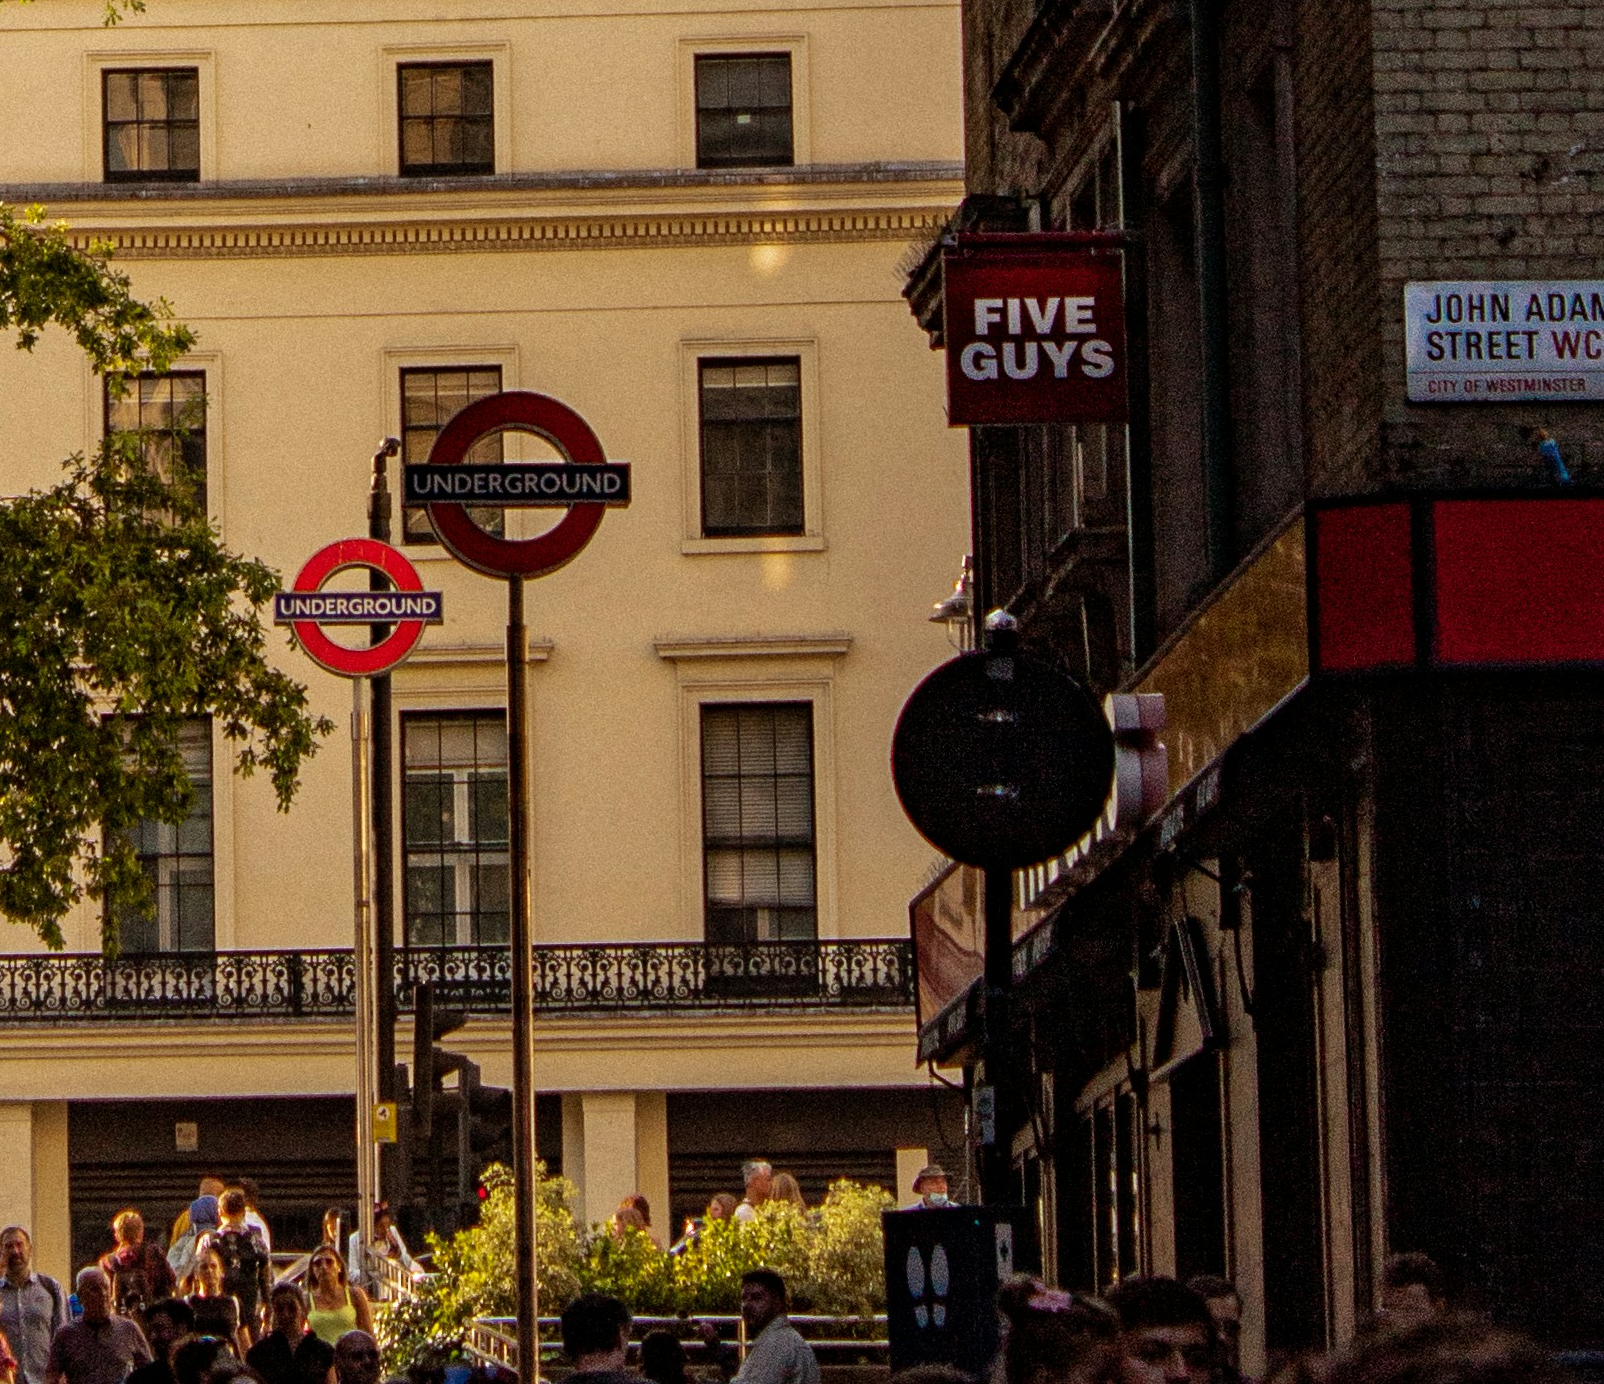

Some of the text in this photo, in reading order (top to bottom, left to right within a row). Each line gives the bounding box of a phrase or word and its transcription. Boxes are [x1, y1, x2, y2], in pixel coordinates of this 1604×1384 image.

[974, 297, 1096, 335] FIVE
[1426, 293, 1510, 324] JOHN
[960, 339, 1115, 380] GUYS
[1427, 330, 1539, 361] STREET
[1427, 377, 1586, 394] CITY OF WESTMINSTER
[413, 472, 621, 494] UNDERGROUND
[280, 597, 437, 616] UNDERGROUND
